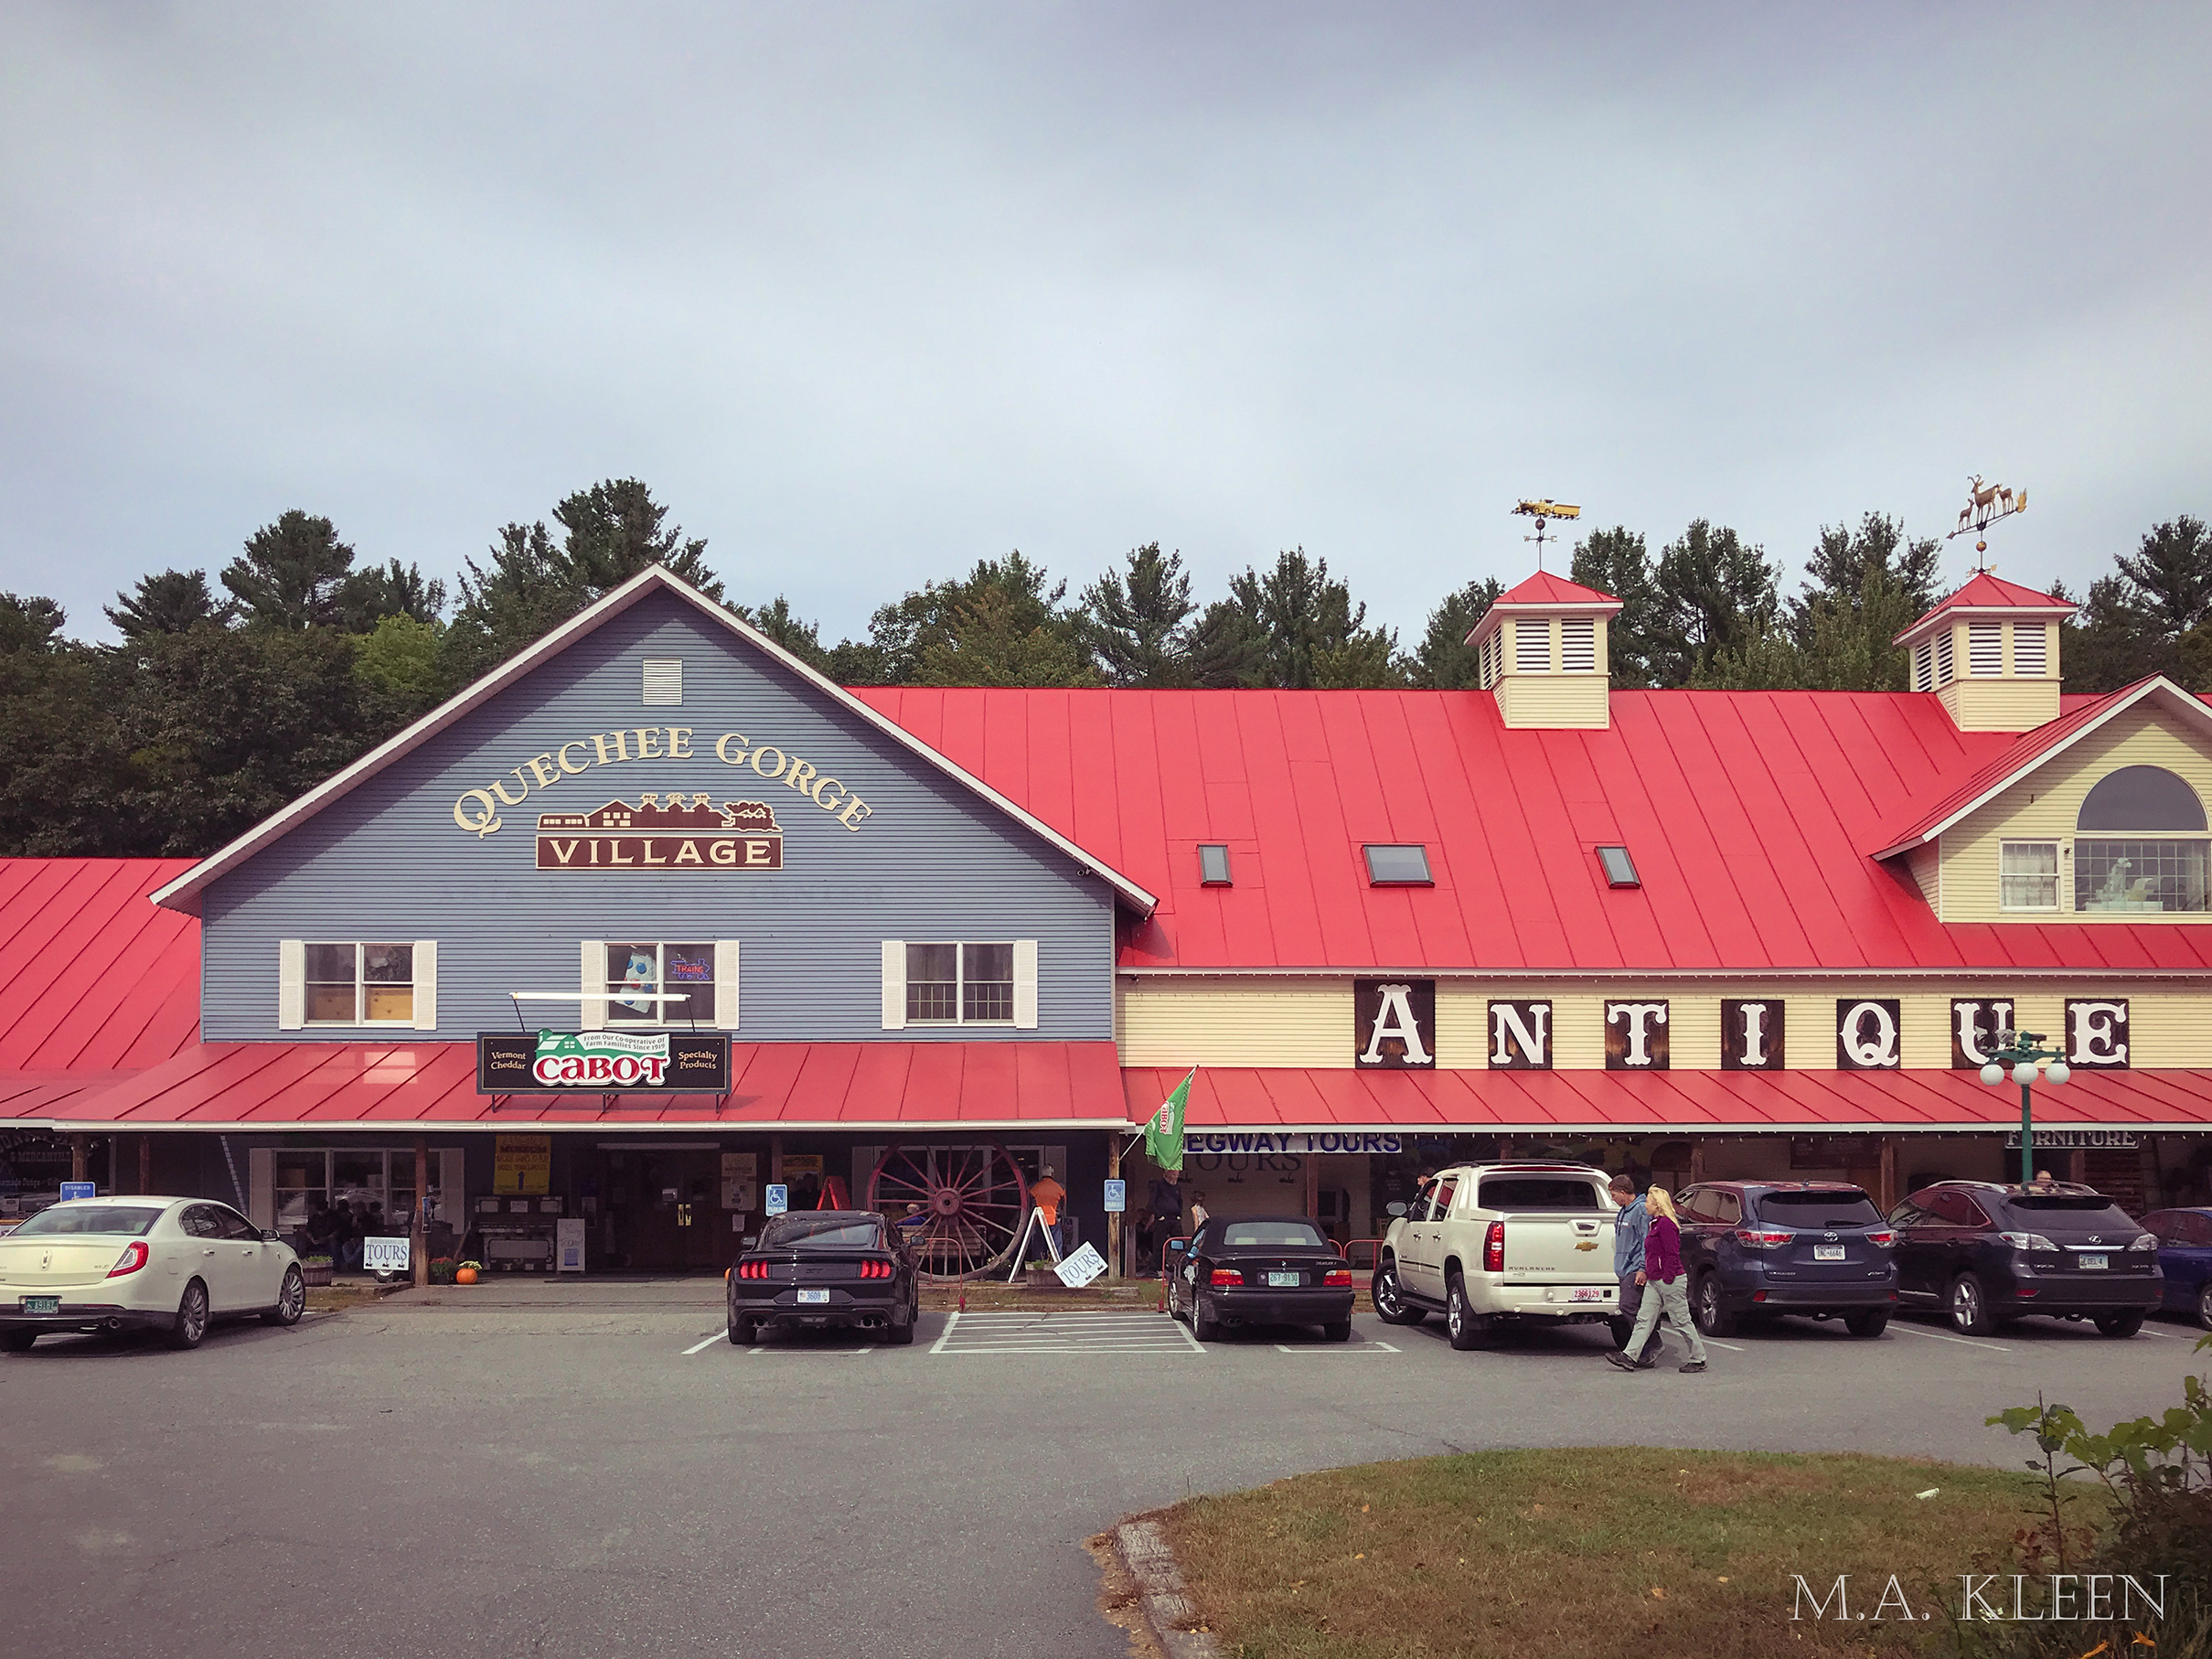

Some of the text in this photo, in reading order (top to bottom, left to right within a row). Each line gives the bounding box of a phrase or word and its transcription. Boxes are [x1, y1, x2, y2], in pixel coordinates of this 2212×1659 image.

[453, 727, 873, 839] QUECHEE GORGE
[550, 840, 772, 864] VILLAGE
[677, 965, 704, 974] TRAINS
[491, 1051, 527, 1060] Vermont
[678, 1051, 718, 1062] Specialty
[490, 1060, 527, 1070] Cheddar
[679, 1060, 717, 1070] Products
[1182, 1132, 1292, 1152] EGWAY
[2007, 1130, 2137, 1146] FRNITURE
[1184, 1153, 1301, 1172] OURS
[367, 1244, 407, 1260] TOURS
[1060, 1248, 1100, 1284] TOURS
